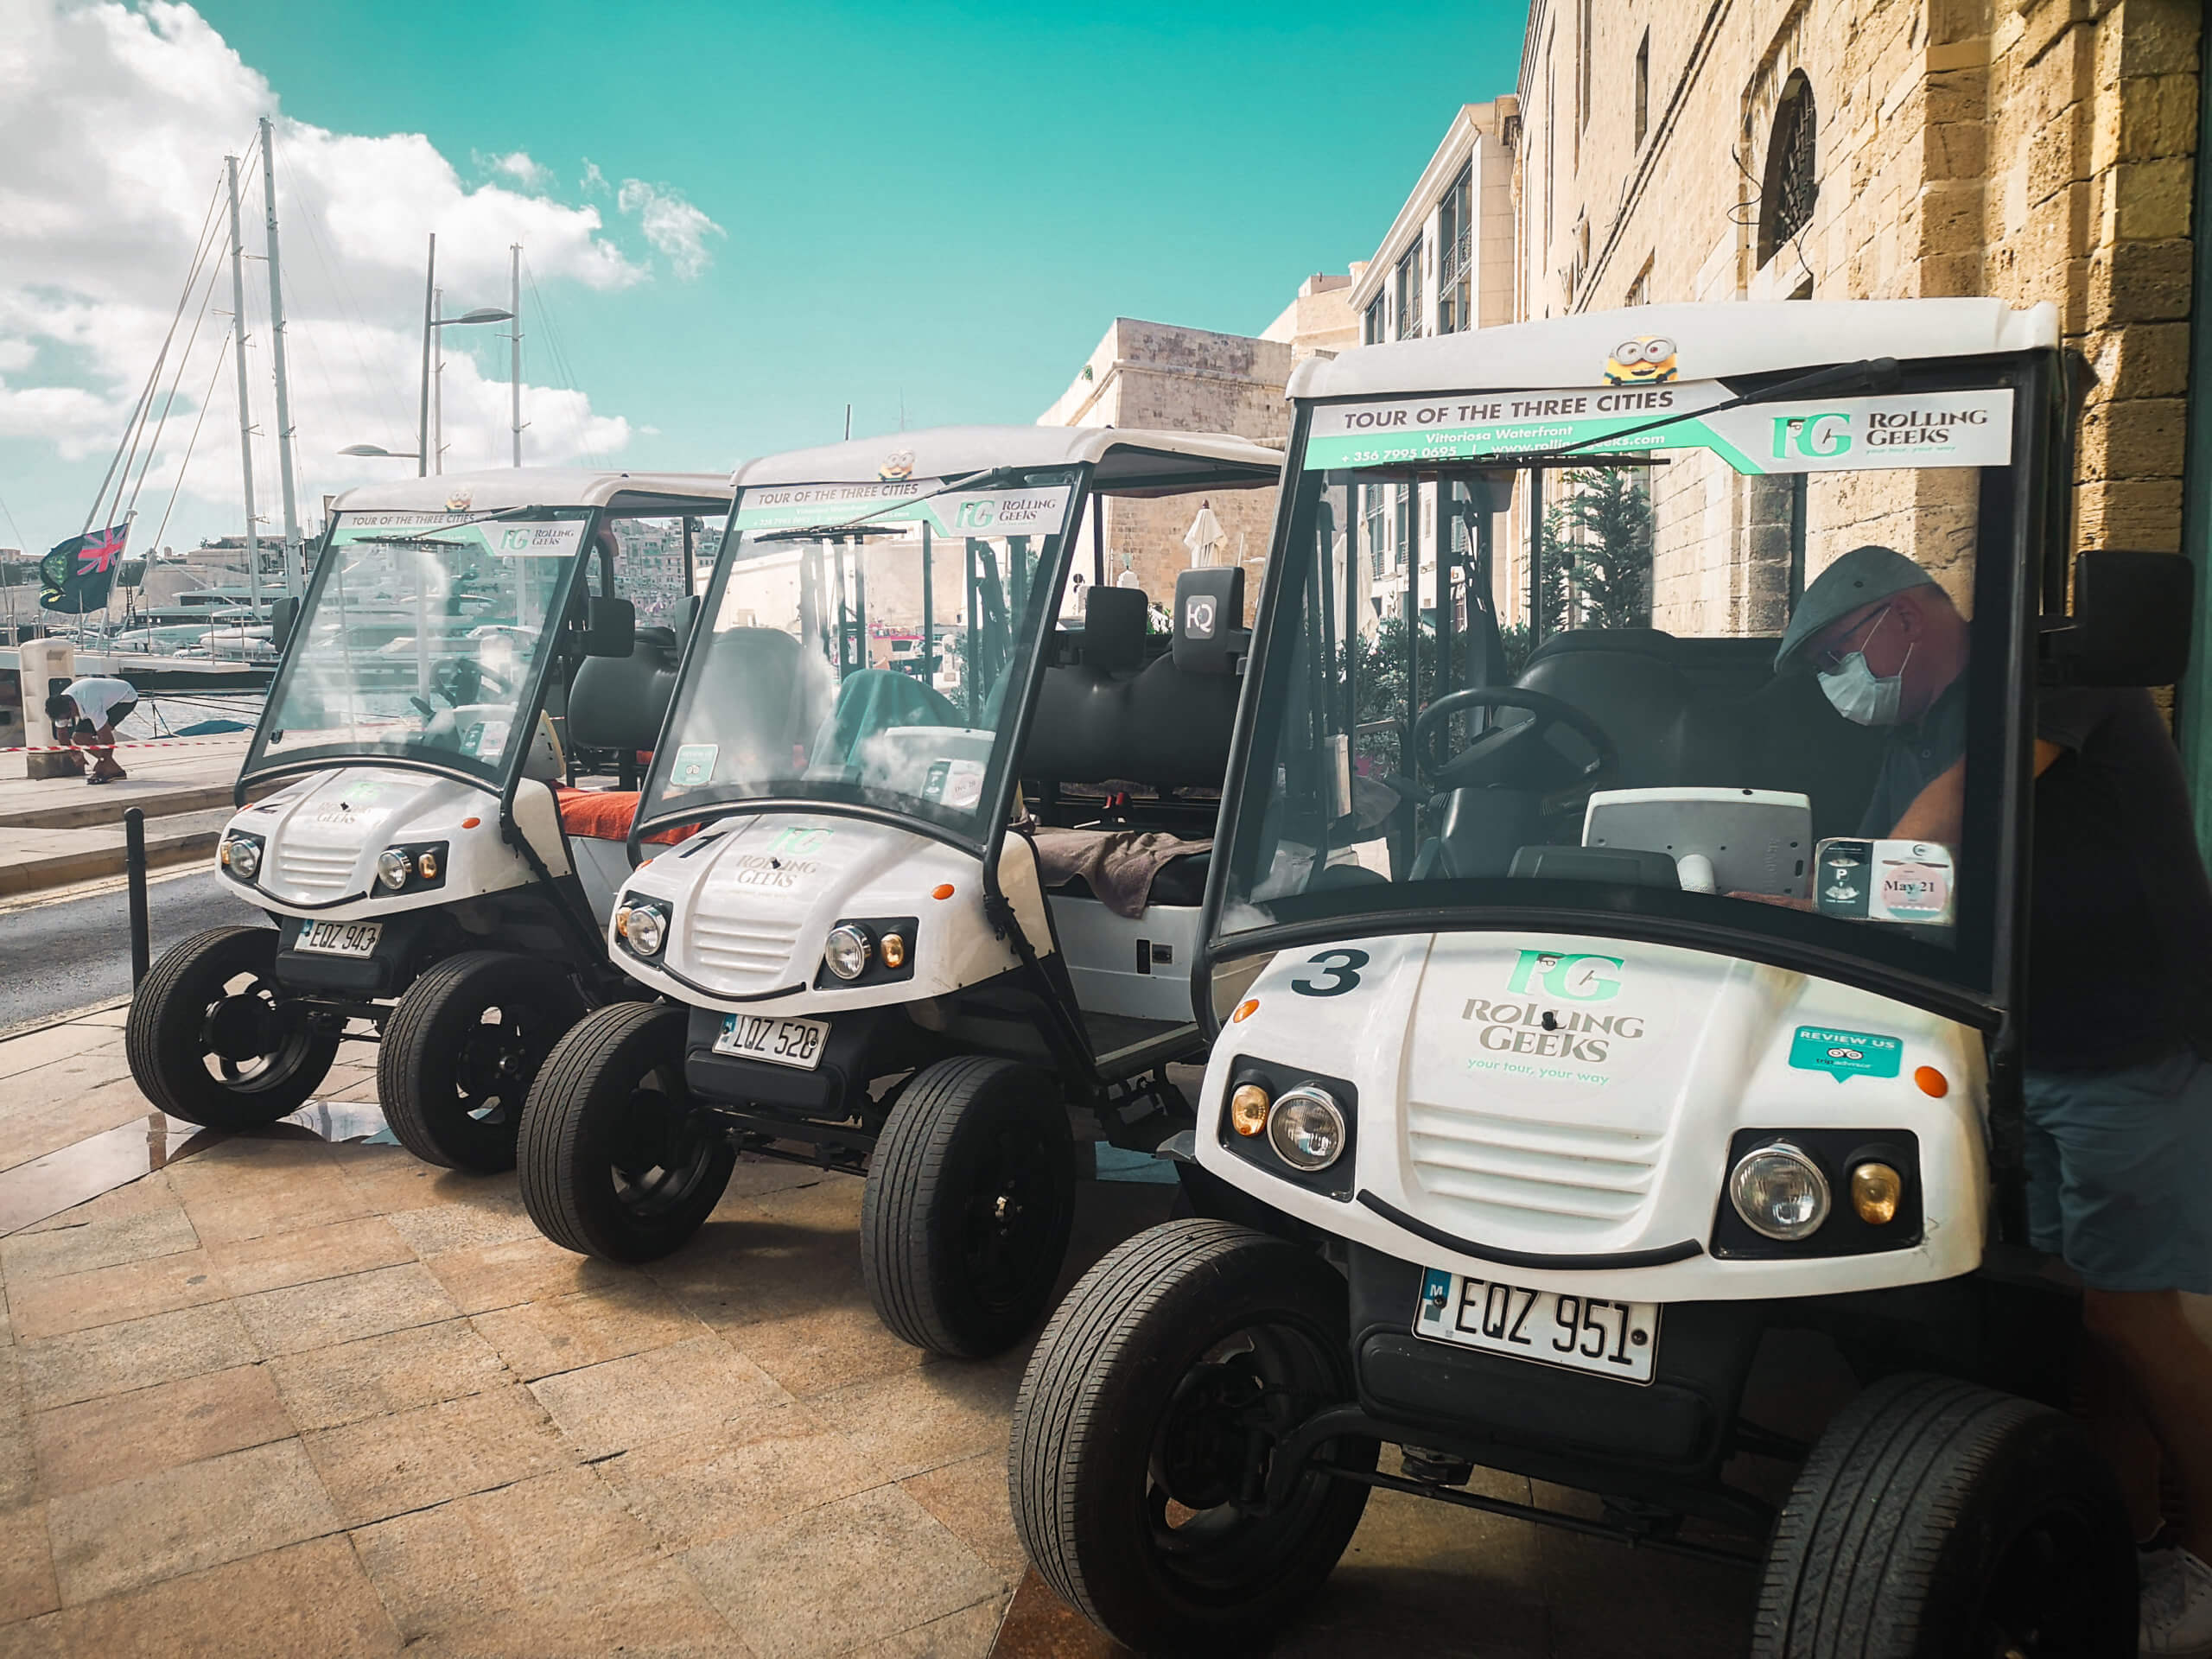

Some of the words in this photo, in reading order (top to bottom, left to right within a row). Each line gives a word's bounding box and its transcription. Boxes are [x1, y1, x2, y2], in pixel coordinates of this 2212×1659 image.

[1344, 410, 1408, 429] TOUR
[1416, 406, 1449, 424] OF
[1458, 403, 1502, 423] THE
[1510, 397, 1588, 419] THREE
[1596, 390, 1675, 412] CITIES
[1869, 409, 1987, 429] ROLLING
[1426, 431, 1491, 444] Vittoriosa
[1495, 425, 1573, 440] Waterfront
[1866, 427, 1949, 447] GEEKS
[1353, 450, 1379, 462] 356
[1383, 448, 1418, 461] 7995
[1422, 445, 1457, 457] 0695
[759, 493, 791, 505] TOUR
[794, 490, 811, 503] OF
[815, 488, 837, 501] THE
[840, 486, 878, 499] THREE
[881, 483, 919, 496] CITIES
[1001, 499, 1057, 511] ROLLING
[352, 517, 378, 526] TOUR
[379, 516, 394, 525] OF
[396, 515, 414, 524] THE
[416, 514, 445, 524] THREE
[446, 513, 475, 524] CITIES
[1835, 868, 1848, 880] P
[1884, 880, 1915, 895] May
[1920, 881, 1936, 893] 21
[309, 922, 344, 949] EQZ
[1291, 948, 1370, 998] 3
[774, 1022, 819, 1059] 528
[1479, 1025, 1610, 1063] GEEKS
[1800, 1030, 1867, 1045] REVIEW
[1872, 1039, 1895, 1049] US
[1467, 1058, 1501, 1070] your
[1503, 1060, 1535, 1075] tour,
[1539, 1066, 1573, 1079] your
[1577, 1071, 1610, 1086] way
[1454, 1276, 1539, 1346] EQZ
[1552, 1295, 1633, 1365] 951
